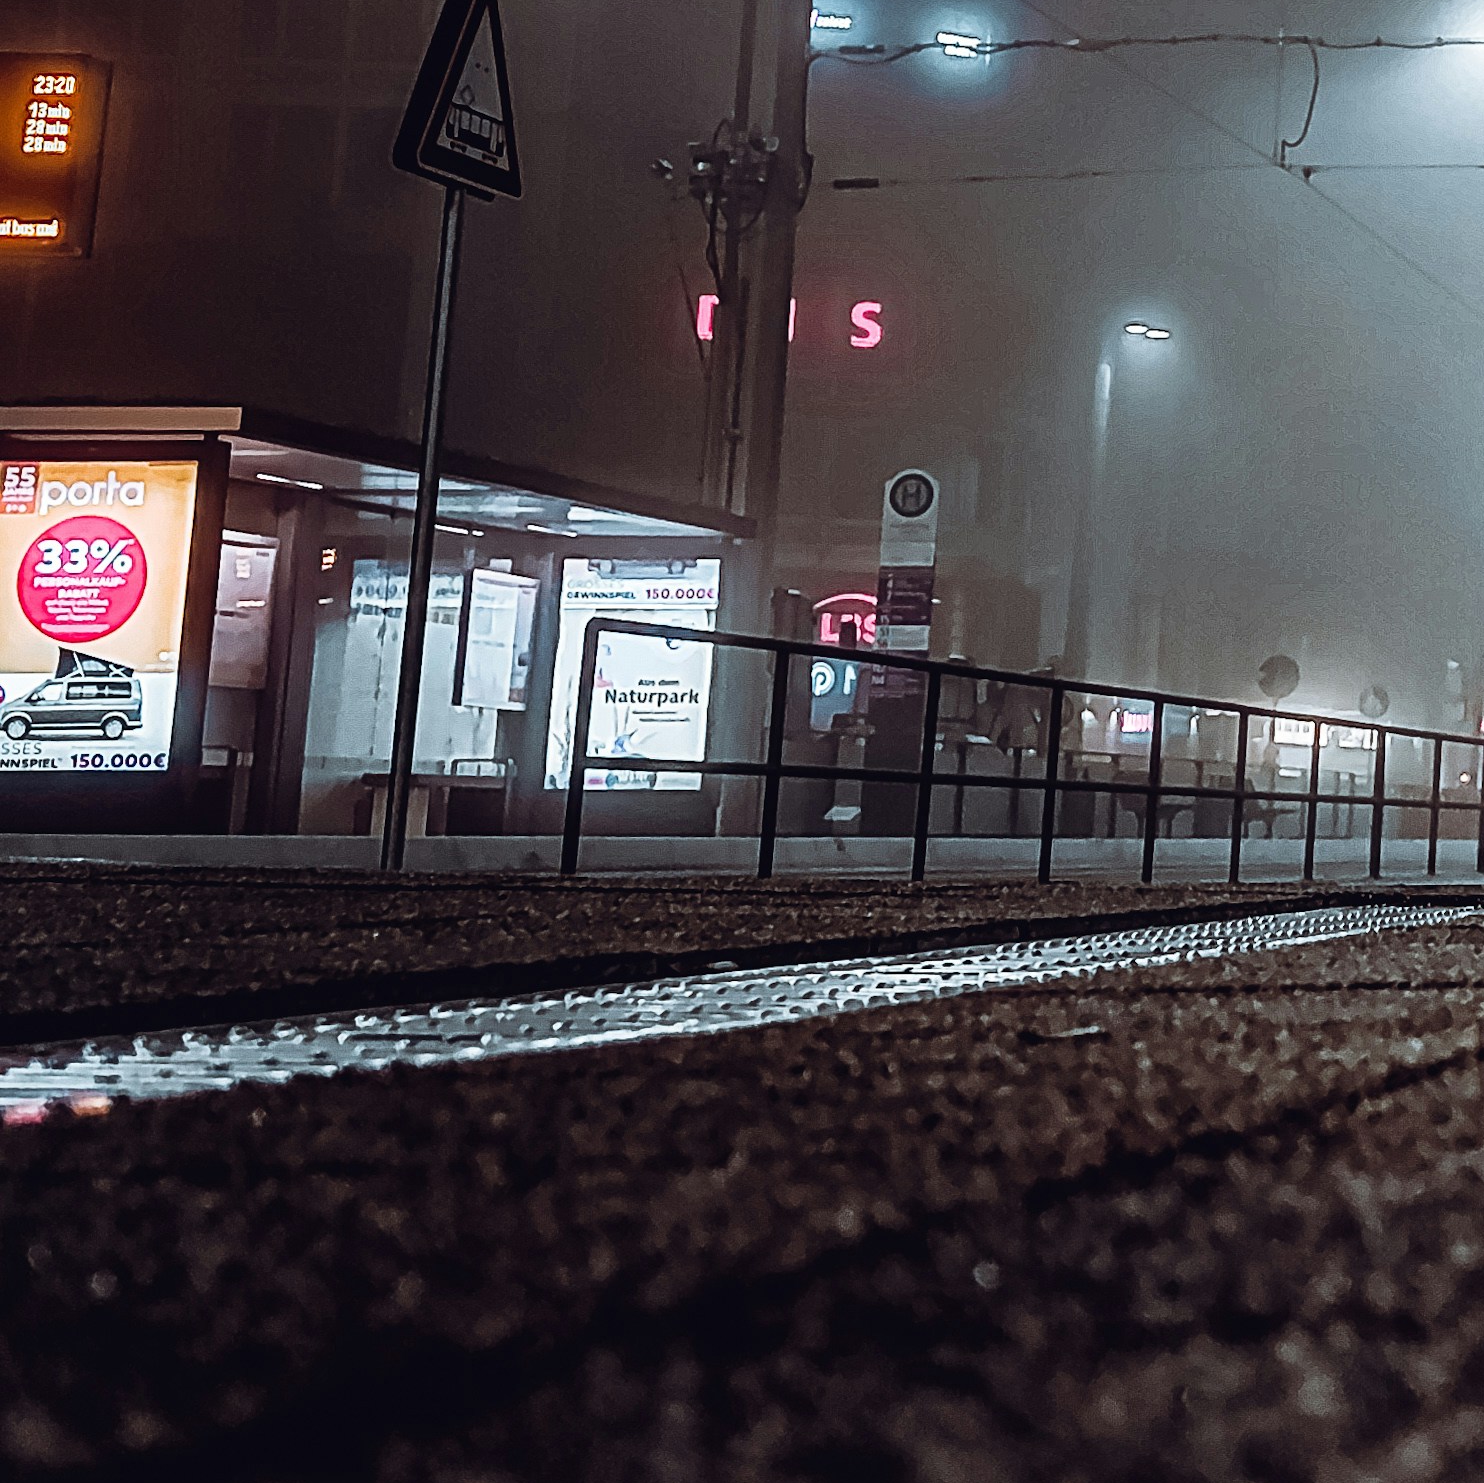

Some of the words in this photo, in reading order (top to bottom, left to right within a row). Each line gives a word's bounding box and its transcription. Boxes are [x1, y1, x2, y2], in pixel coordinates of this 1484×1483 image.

[5, 466, 36, 488] 55
[39, 470, 146, 516] porta
[645, 587, 715, 600] 150.000€
[604, 688, 700, 707] Naturpark
[70, 752, 167, 769] 150.000€
